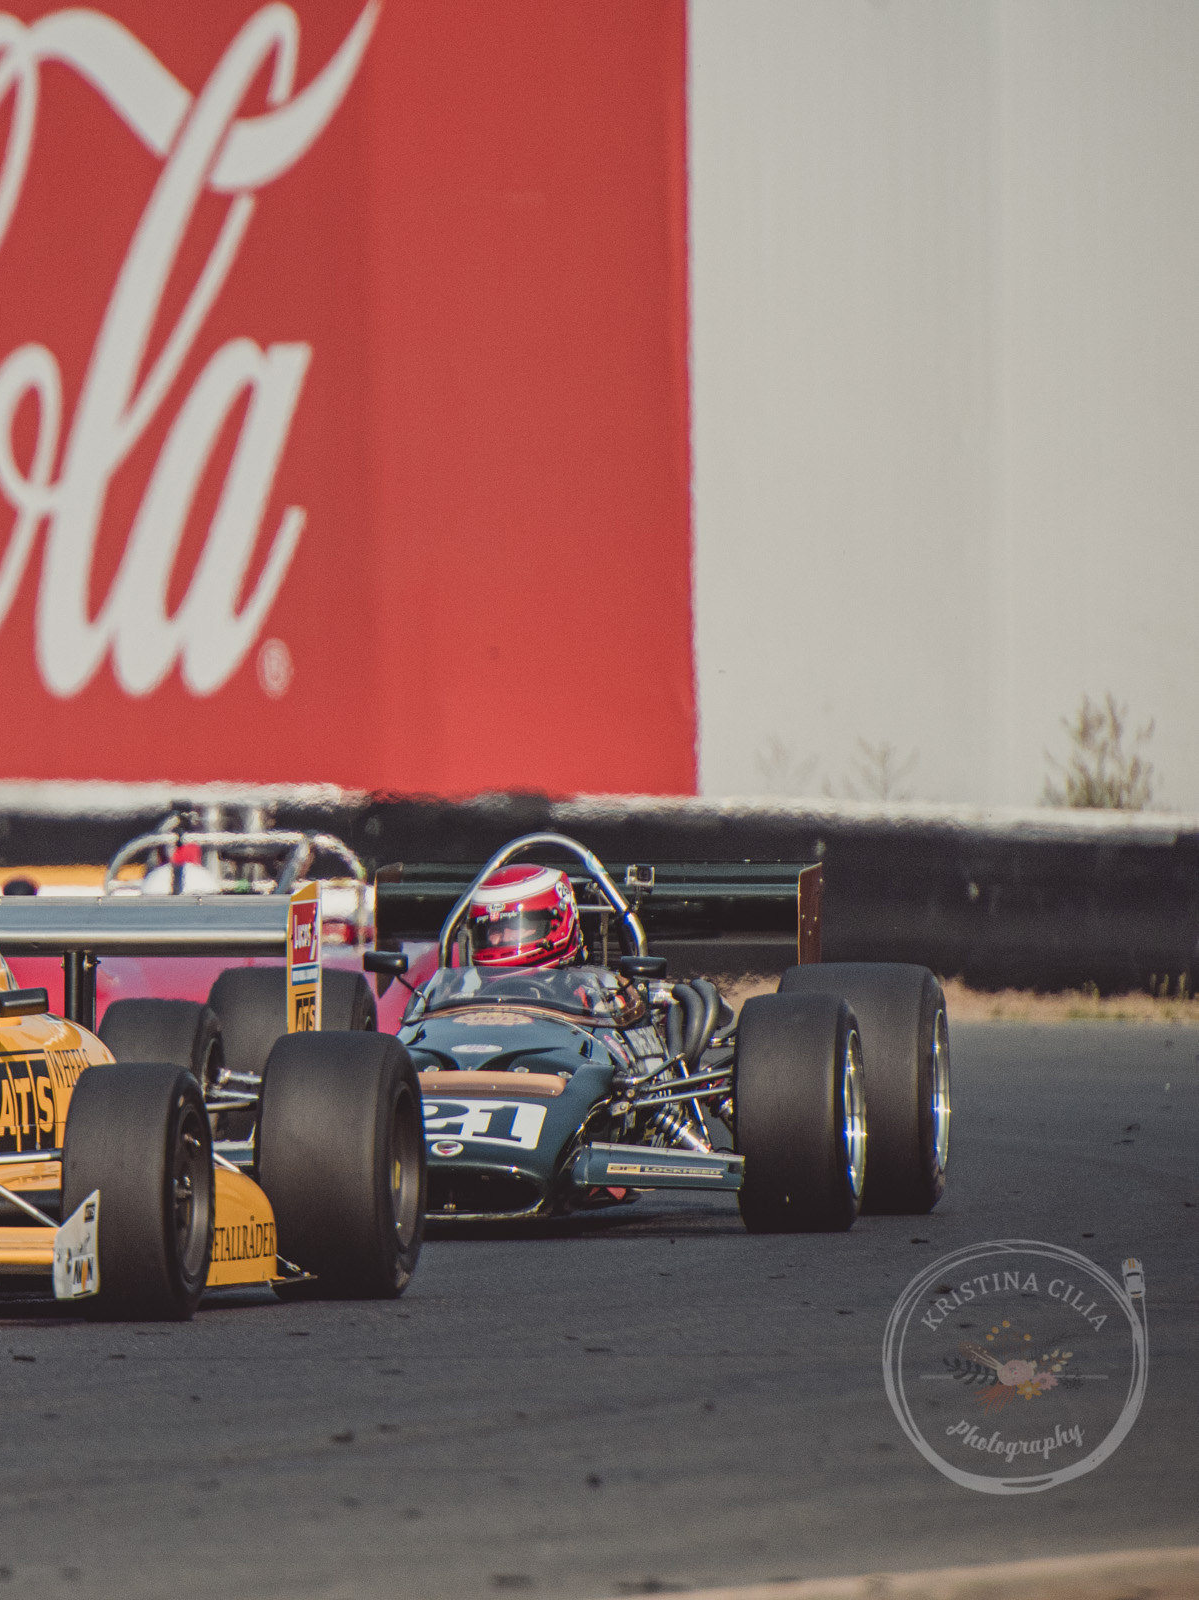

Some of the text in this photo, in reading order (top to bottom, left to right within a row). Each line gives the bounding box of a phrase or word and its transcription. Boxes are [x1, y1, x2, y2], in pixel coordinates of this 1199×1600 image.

[297, 1003, 316, 1033] ATS
[423, 1101, 523, 1143] 21
[644, 1166, 721, 1175] LOCKHEED
